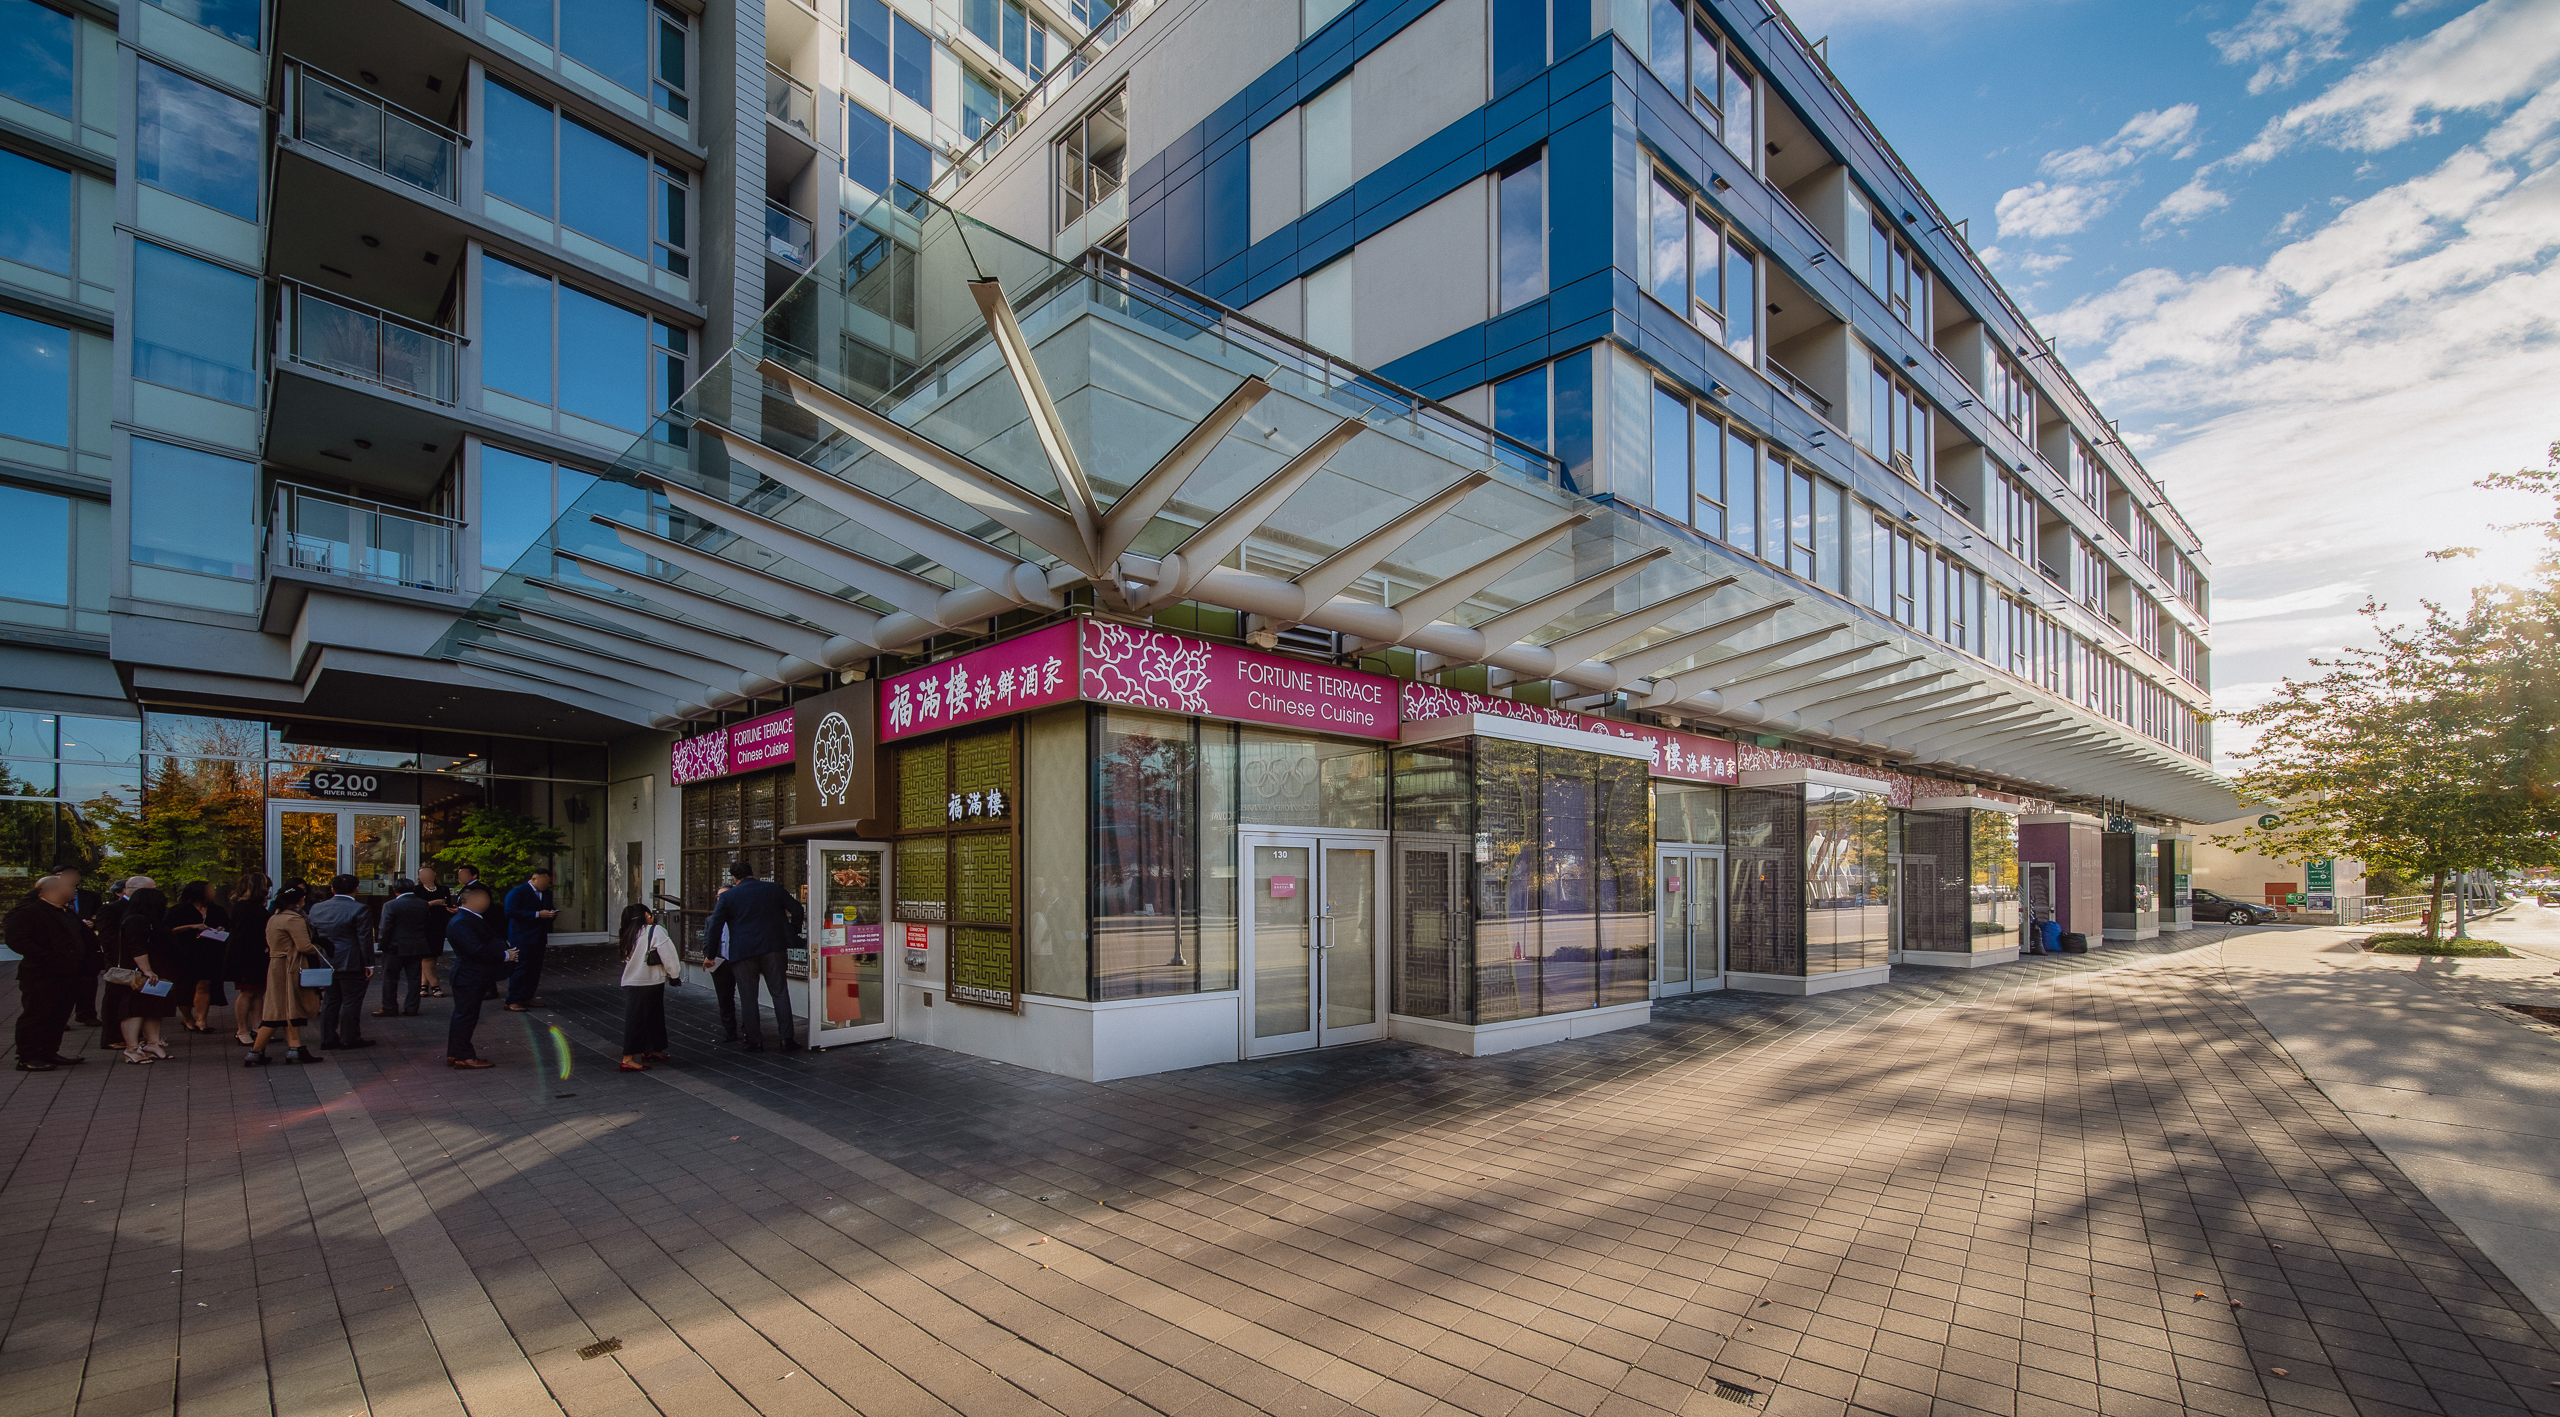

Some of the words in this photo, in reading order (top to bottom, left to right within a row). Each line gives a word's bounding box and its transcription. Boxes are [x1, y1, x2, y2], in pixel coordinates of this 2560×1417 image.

[1238, 660, 1313, 693] FORTUNE
[1317, 675, 1382, 704] TERRACE
[1247, 690, 1315, 718] Chinese
[1320, 702, 1374, 726] Cuisine
[734, 726, 762, 747] FORTUNE
[763, 717, 793, 740] TERRACE
[737, 748, 763, 765] Chinese
[764, 742, 789, 759] Cuisine
[314, 773, 378, 792] 6200
[948, 788, 1004, 822] 福滿樓
[840, 853, 857, 862] 130
[1273, 850, 1288, 859] 130
[2315, 859, 2325, 868] P
